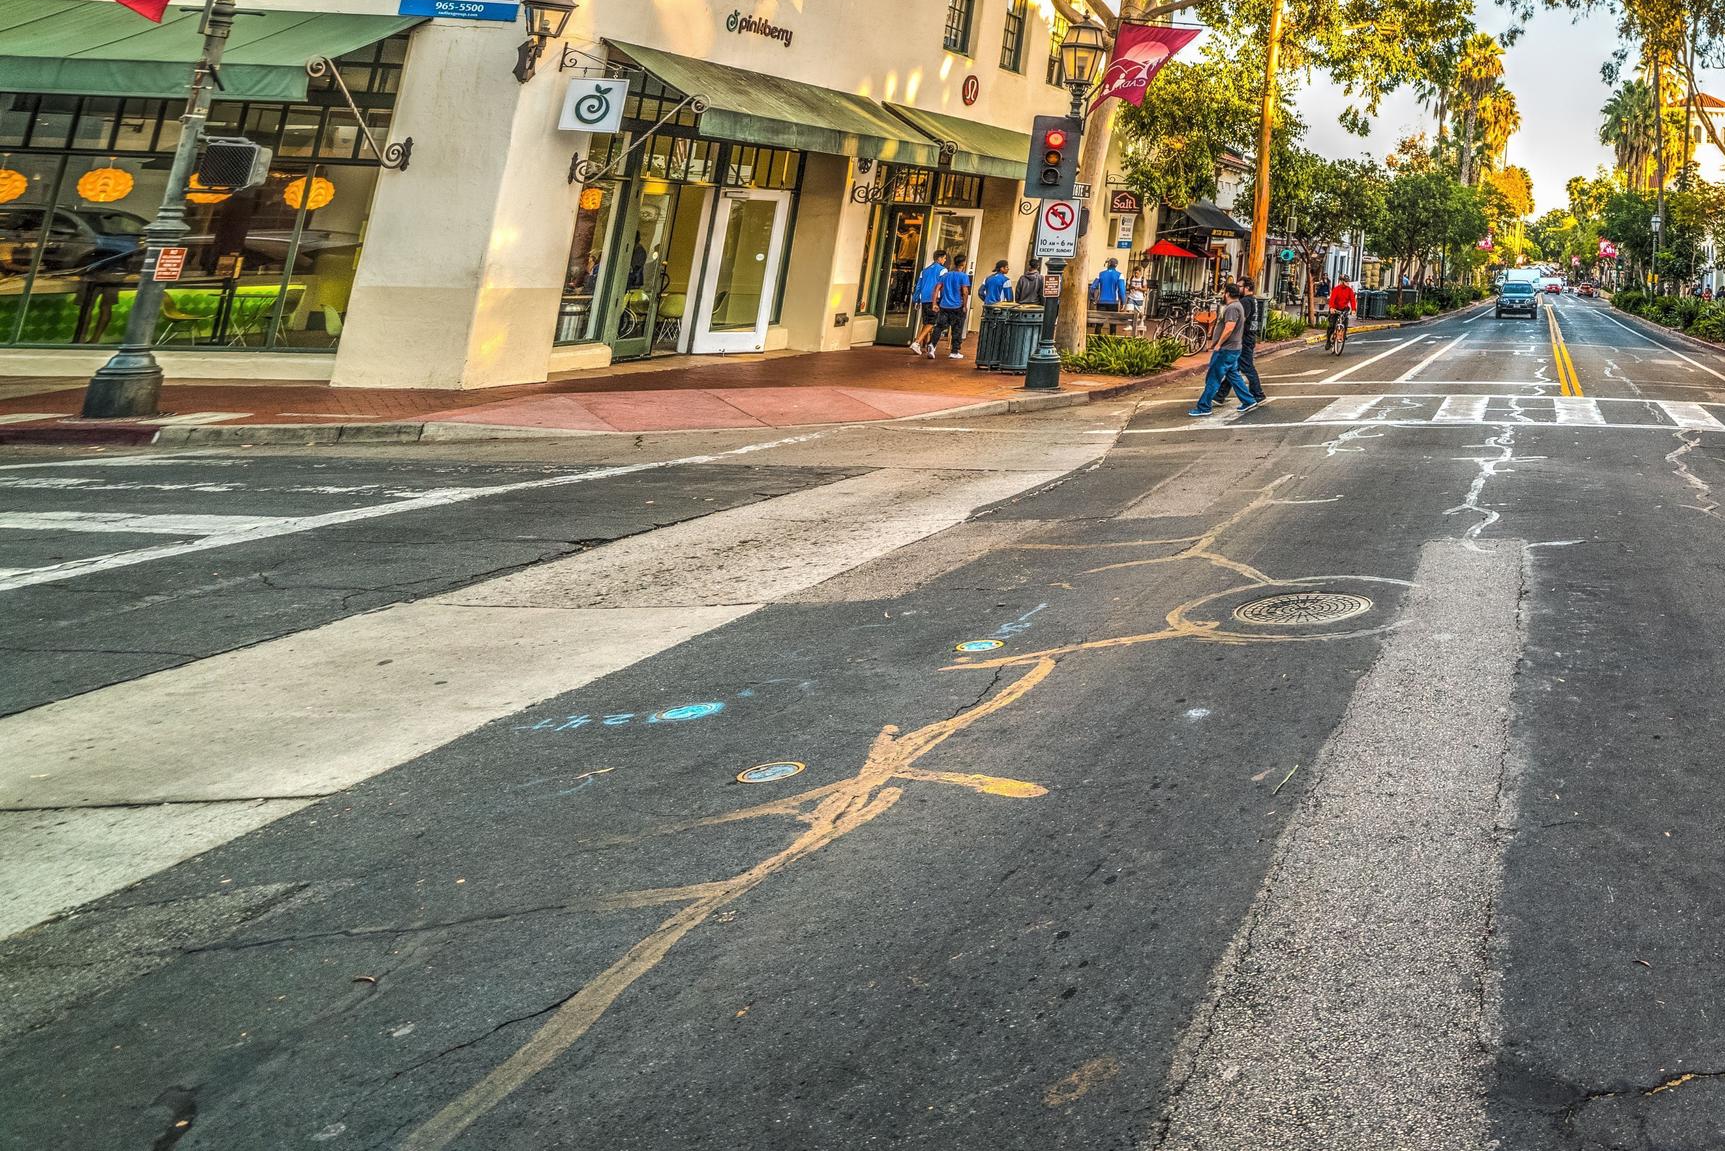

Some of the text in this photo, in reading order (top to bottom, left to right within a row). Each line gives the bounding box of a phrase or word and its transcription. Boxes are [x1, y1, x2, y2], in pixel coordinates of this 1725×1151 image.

[435, 1, 484, 13] 965-5500
[738, 14, 793, 48] pinkberry
[1072, 184, 1084, 196] TATE
[1113, 198, 1133, 209] Salt
